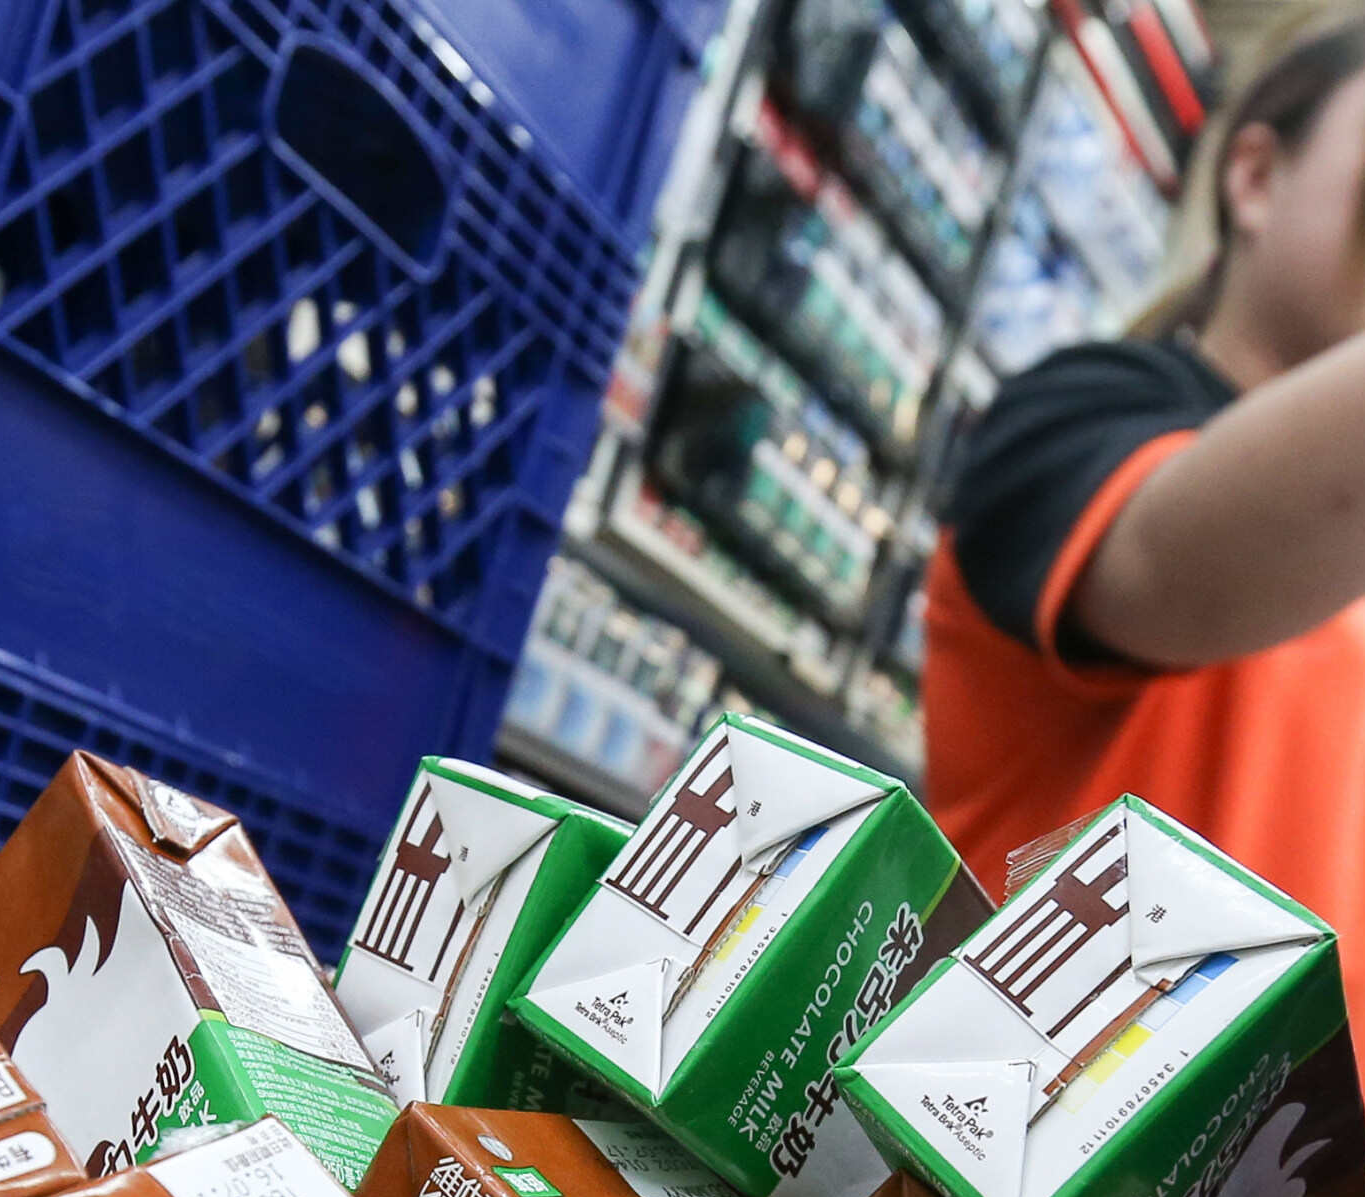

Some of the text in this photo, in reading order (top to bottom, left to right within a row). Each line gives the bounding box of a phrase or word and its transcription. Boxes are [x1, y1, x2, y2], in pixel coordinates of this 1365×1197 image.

[573, 1000, 591, 1018] Tetra
[601, 1022, 628, 1045] Aseptic
[590, 996, 613, 1017] Tetra
[731, 899, 874, 1145] CHOCOLATE MILK
[726, 1048, 777, 1129] BEVERAGE
[939, 1093, 969, 1123] Tetra
[918, 1094, 942, 1117] Tetra
[952, 1128, 989, 1163] Aseptic
